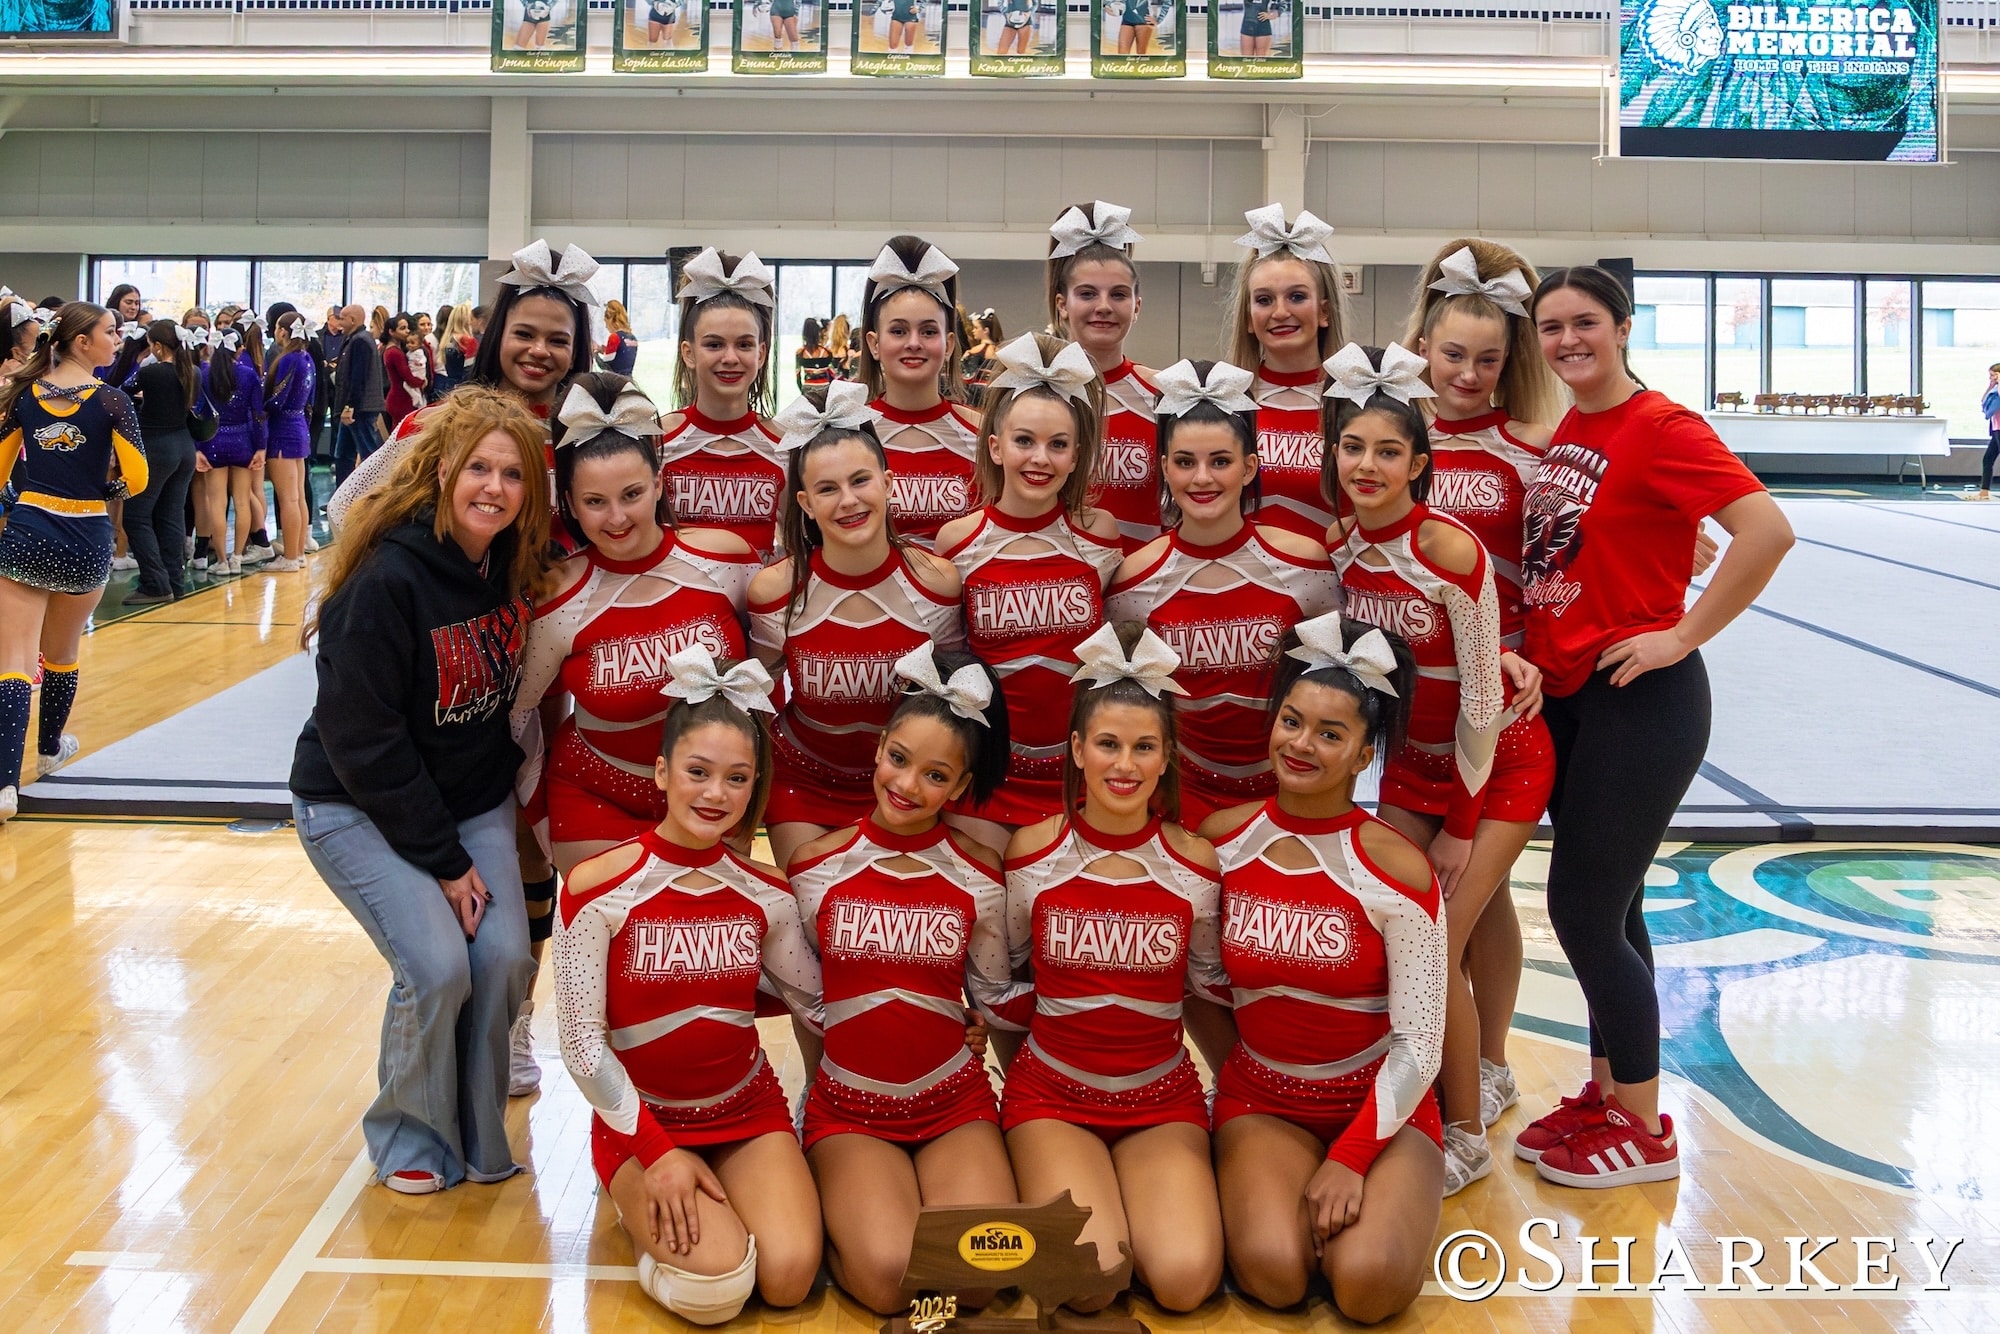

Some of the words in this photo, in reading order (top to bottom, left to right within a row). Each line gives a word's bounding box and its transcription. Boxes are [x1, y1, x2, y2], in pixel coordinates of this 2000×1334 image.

[1727, 5, 1916, 33] BILLERICA
[1726, 31, 1916, 57] MEMORIAL
[622, 56, 659, 71] Sophia
[661, 55, 704, 68] daSilva
[739, 58, 776, 69] Emma
[776, 57, 822, 71] Johnson
[856, 59, 902, 75] Meghan
[905, 62, 941, 72] Downs
[978, 59, 1015, 73] Kendra
[1017, 63, 1060, 73] Marino
[1008, 57, 1033, 65] Captain
[1099, 62, 1135, 73] Nicole
[1137, 61, 1177, 74] Guedes
[1214, 62, 1244, 77] Avery
[1246, 63, 1297, 74] Townsend
[1734, 59, 1779, 72] HOME
[1782, 60, 1804, 73] OF
[1806, 61, 1839, 73] THE
[1844, 61, 1910, 75] INDIANS
[1256, 432, 1325, 470] AWK
[673, 475, 777, 519] HAWKS
[886, 477, 968, 516] AWKS
[1425, 471, 1503, 510] AWKS
[974, 582, 1094, 630] HAWKS
[1165, 619, 1282, 669] HAWKS
[801, 658, 904, 700] HAWK
[831, 900, 964, 960] HAWKS
[1047, 911, 1182, 967] HAWKS
[1223, 894, 1353, 963] HAWKS
[632, 919, 758, 975] HAWKS
[970, 1235, 1023, 1250] MSAA
[908, 1295, 957, 1322] 2025
